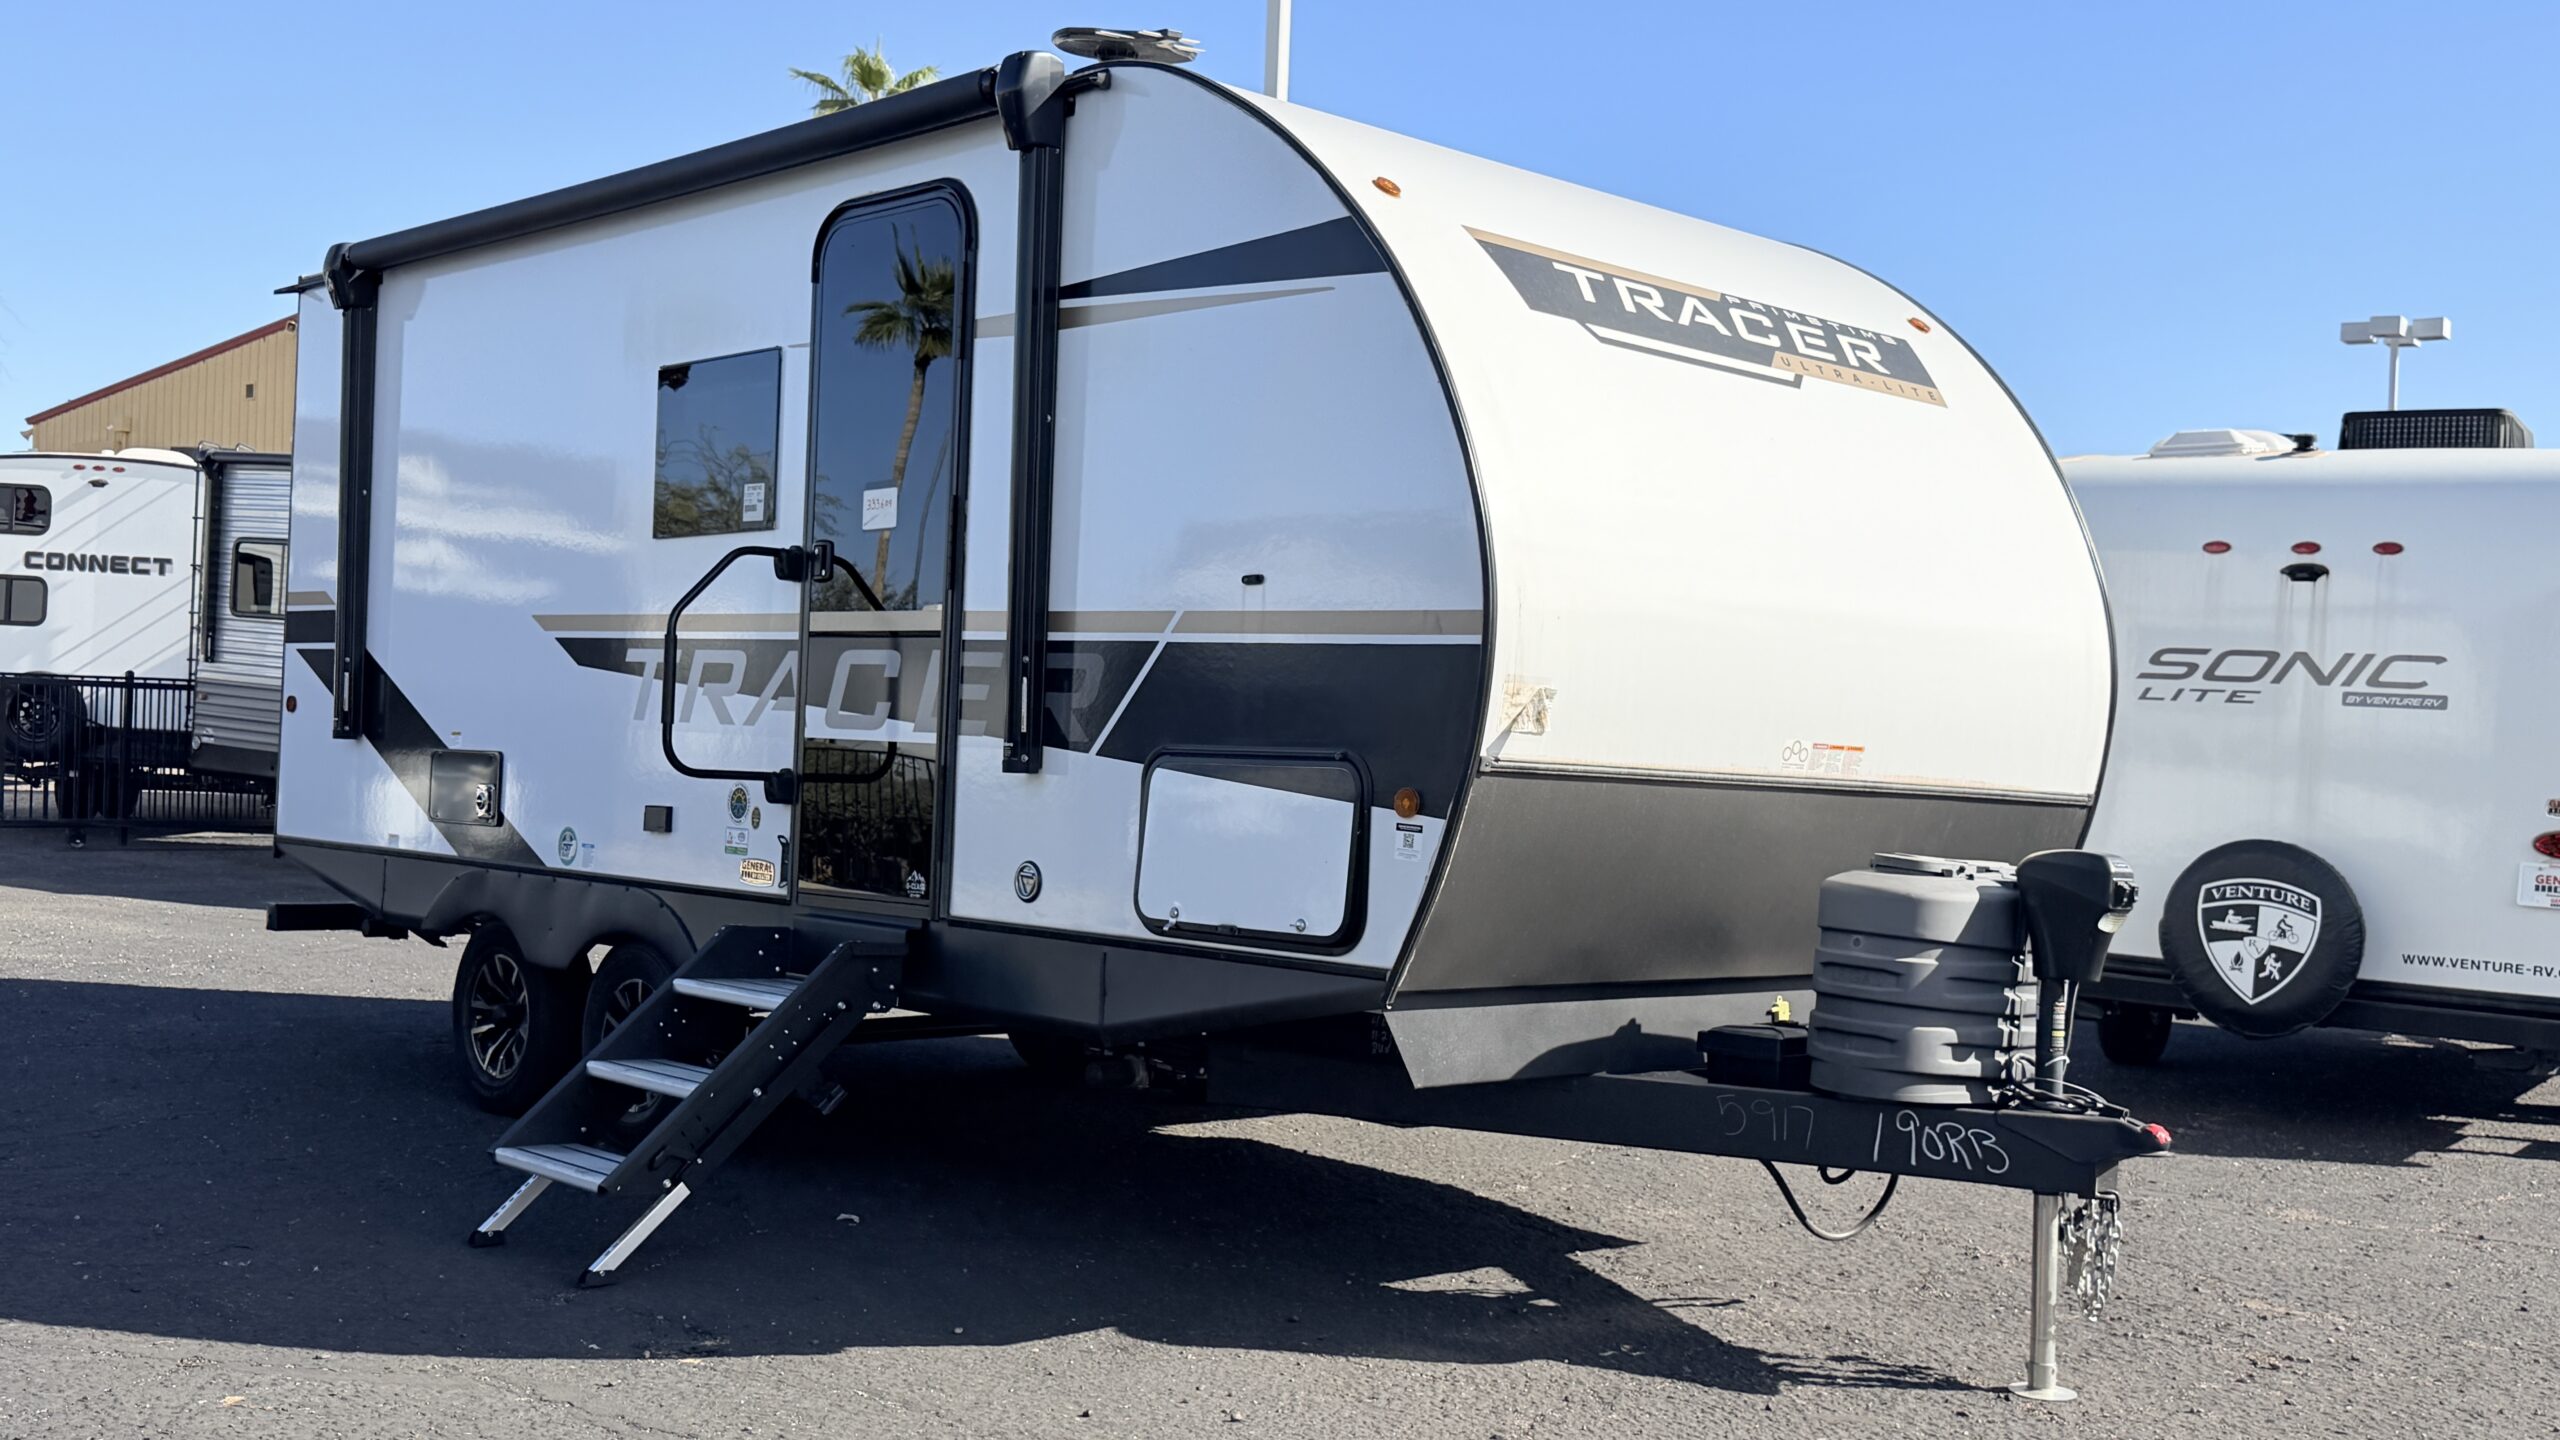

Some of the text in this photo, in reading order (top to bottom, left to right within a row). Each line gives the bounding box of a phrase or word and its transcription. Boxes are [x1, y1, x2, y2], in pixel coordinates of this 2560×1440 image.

[1552, 261, 1891, 375] TRACER
[1780, 356, 1938, 402] ULTRA-LITE
[24, 550, 174, 577] CONNECT
[2136, 647, 2448, 690] SONIC
[625, 648, 1105, 743] TRACER
[2137, 686, 2262, 704] LITE
[2345, 694, 2444, 708] BY VENTURE RV
[741, 860, 773, 873] GENERAL
[2211, 885, 2311, 912] VENTURE
[2401, 953, 2560, 979] WWW.VENTURE-RV.
[1716, 1094, 1814, 1150] 5917
